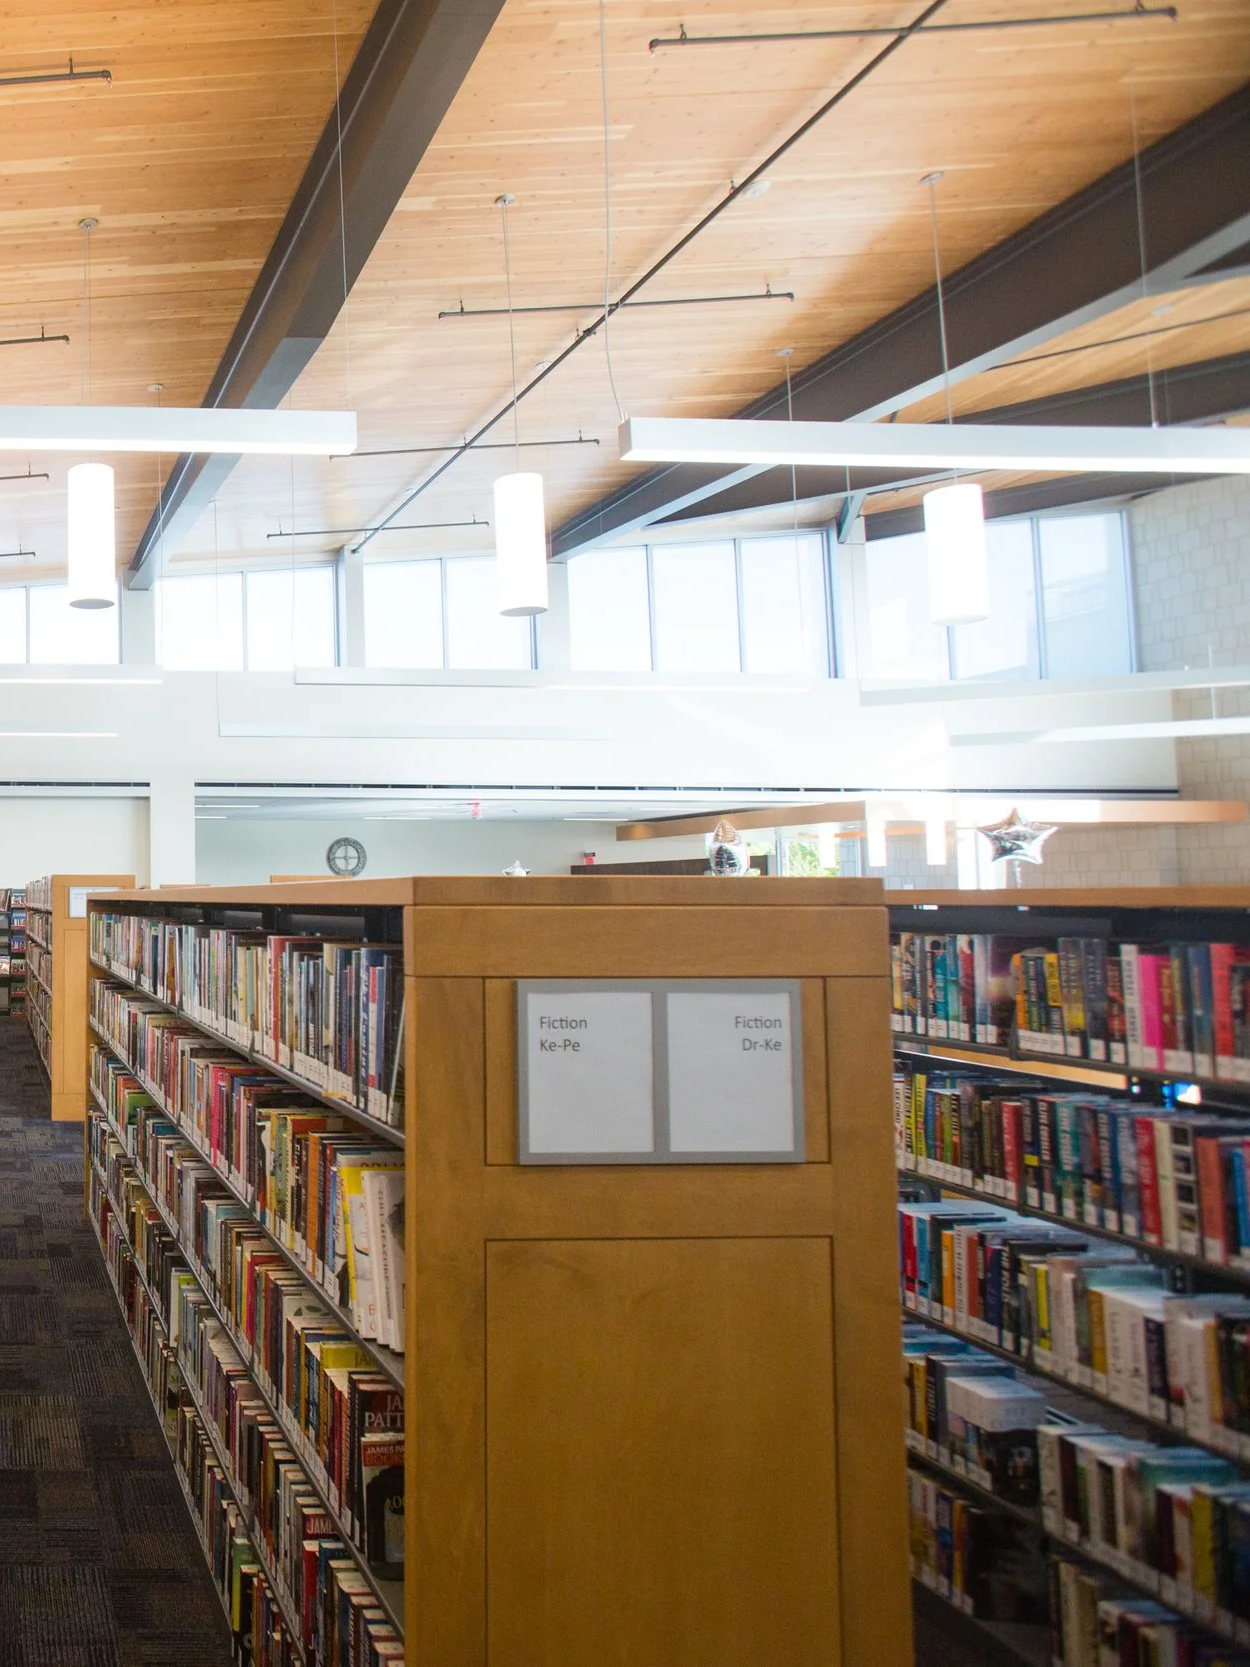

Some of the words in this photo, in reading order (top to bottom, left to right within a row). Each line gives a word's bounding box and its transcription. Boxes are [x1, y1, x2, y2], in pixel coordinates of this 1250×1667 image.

[539, 1016, 588, 1030] Fiction
[734, 1015, 783, 1029] Fiction
[539, 1038, 581, 1052] Ke-Pe
[742, 1038, 782, 1051] Dr-Ke
[365, 1412, 405, 1428] PATT
[366, 1444, 392, 1455] JAMES
